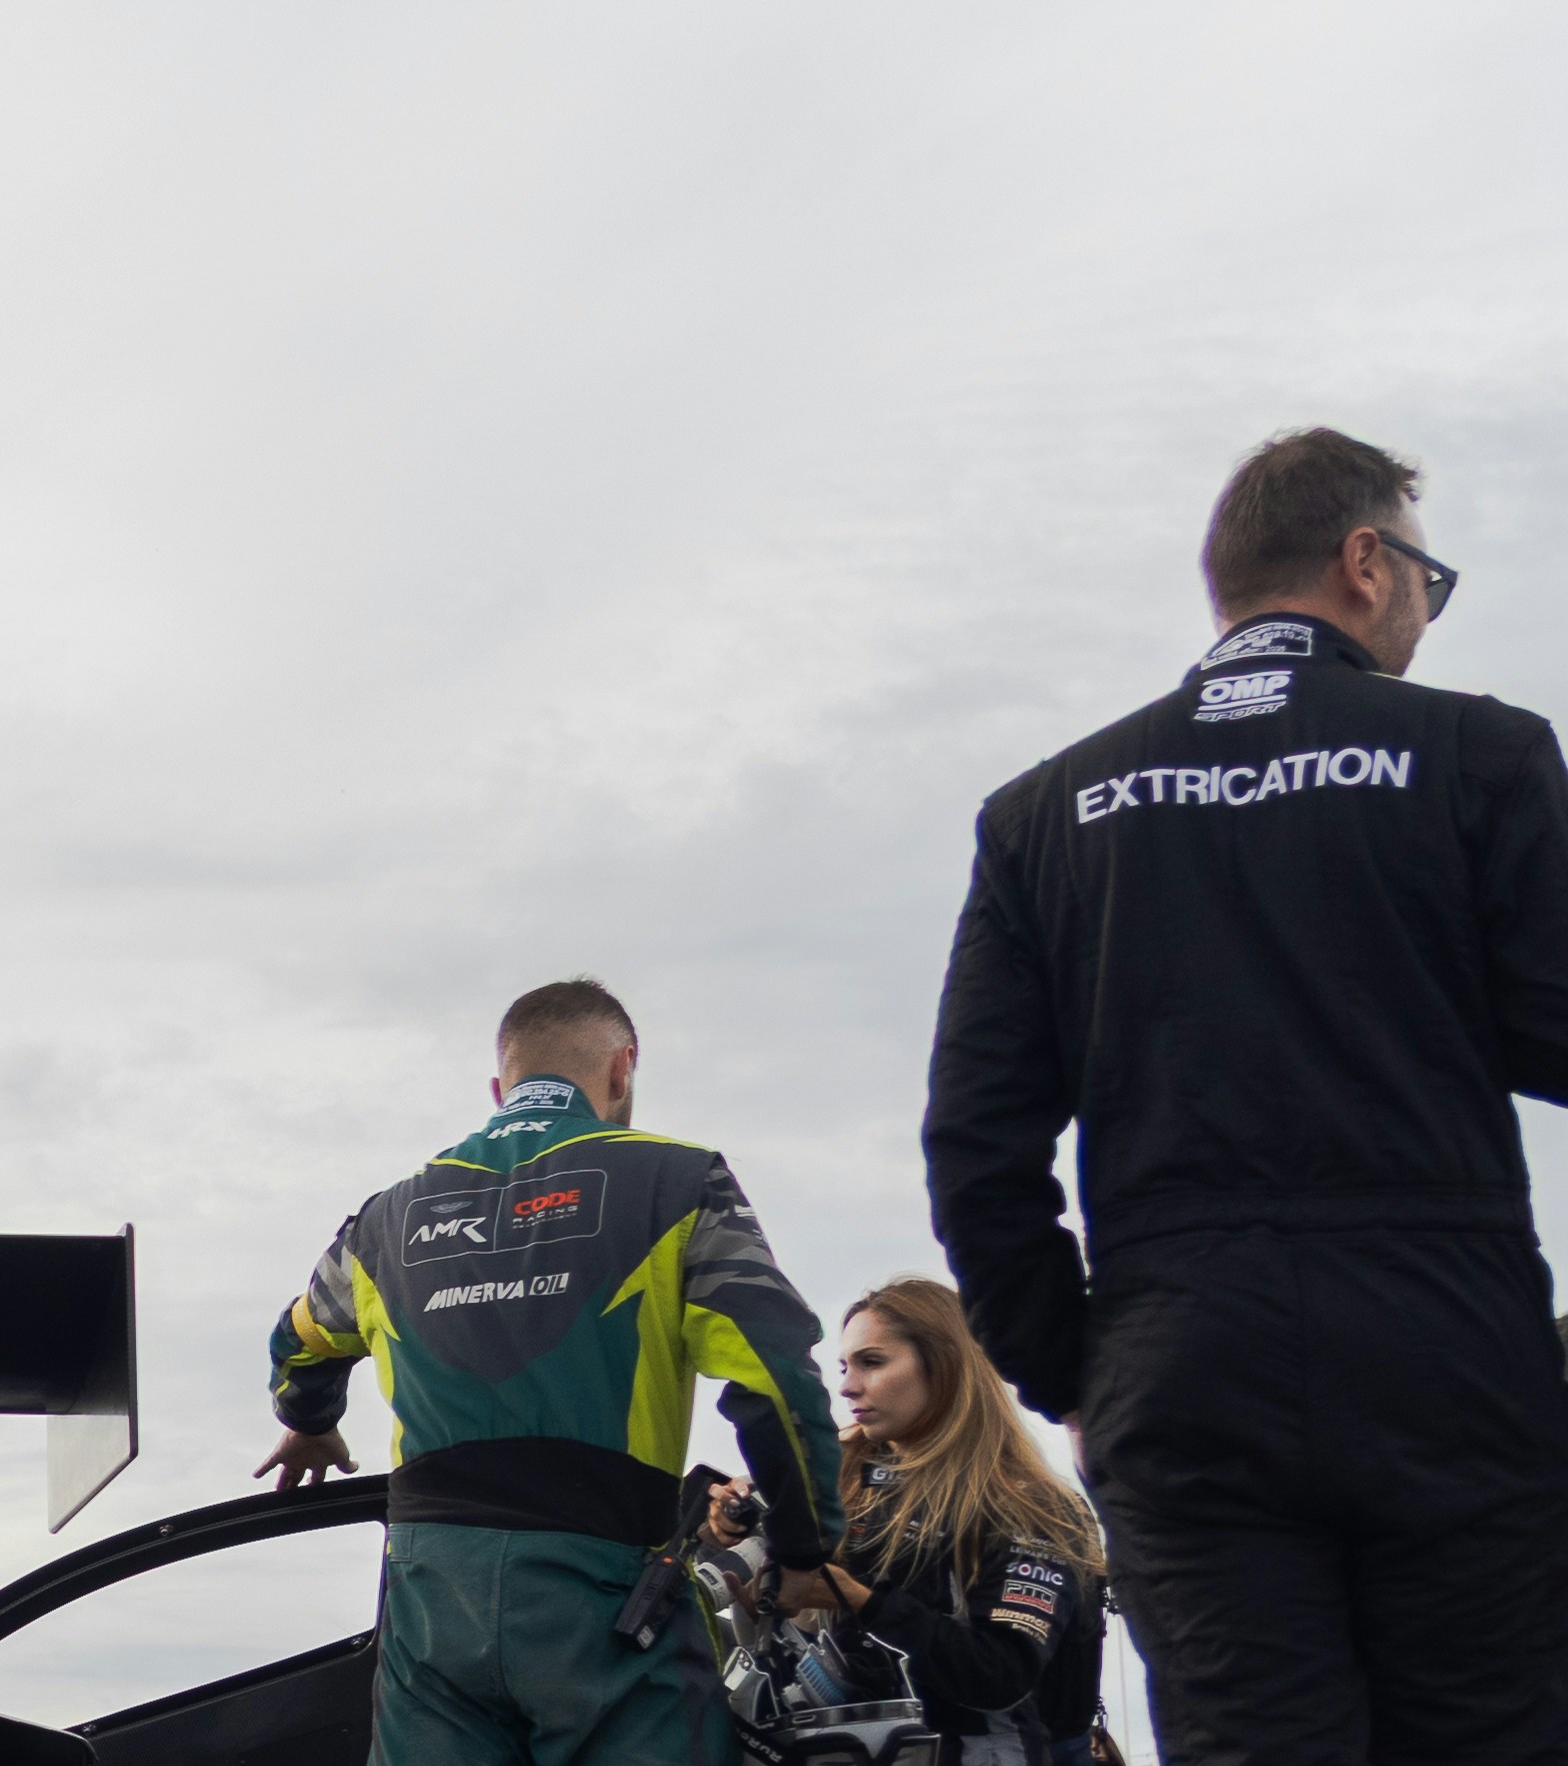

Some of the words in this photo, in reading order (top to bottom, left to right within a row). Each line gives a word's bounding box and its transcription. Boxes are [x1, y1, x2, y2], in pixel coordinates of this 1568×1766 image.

[1201, 676, 1290, 703] OMP
[1194, 701, 1287, 721] SPORT
[1077, 748, 1410, 824] EXTRICATION
[487, 1121, 553, 1139] HRX
[512, 1205, 579, 1225] RACING
[514, 1190, 581, 1215] CODE
[409, 1217, 487, 1245] AMR
[423, 1280, 525, 1312] MINERVA
[532, 1274, 569, 1295] OIL
